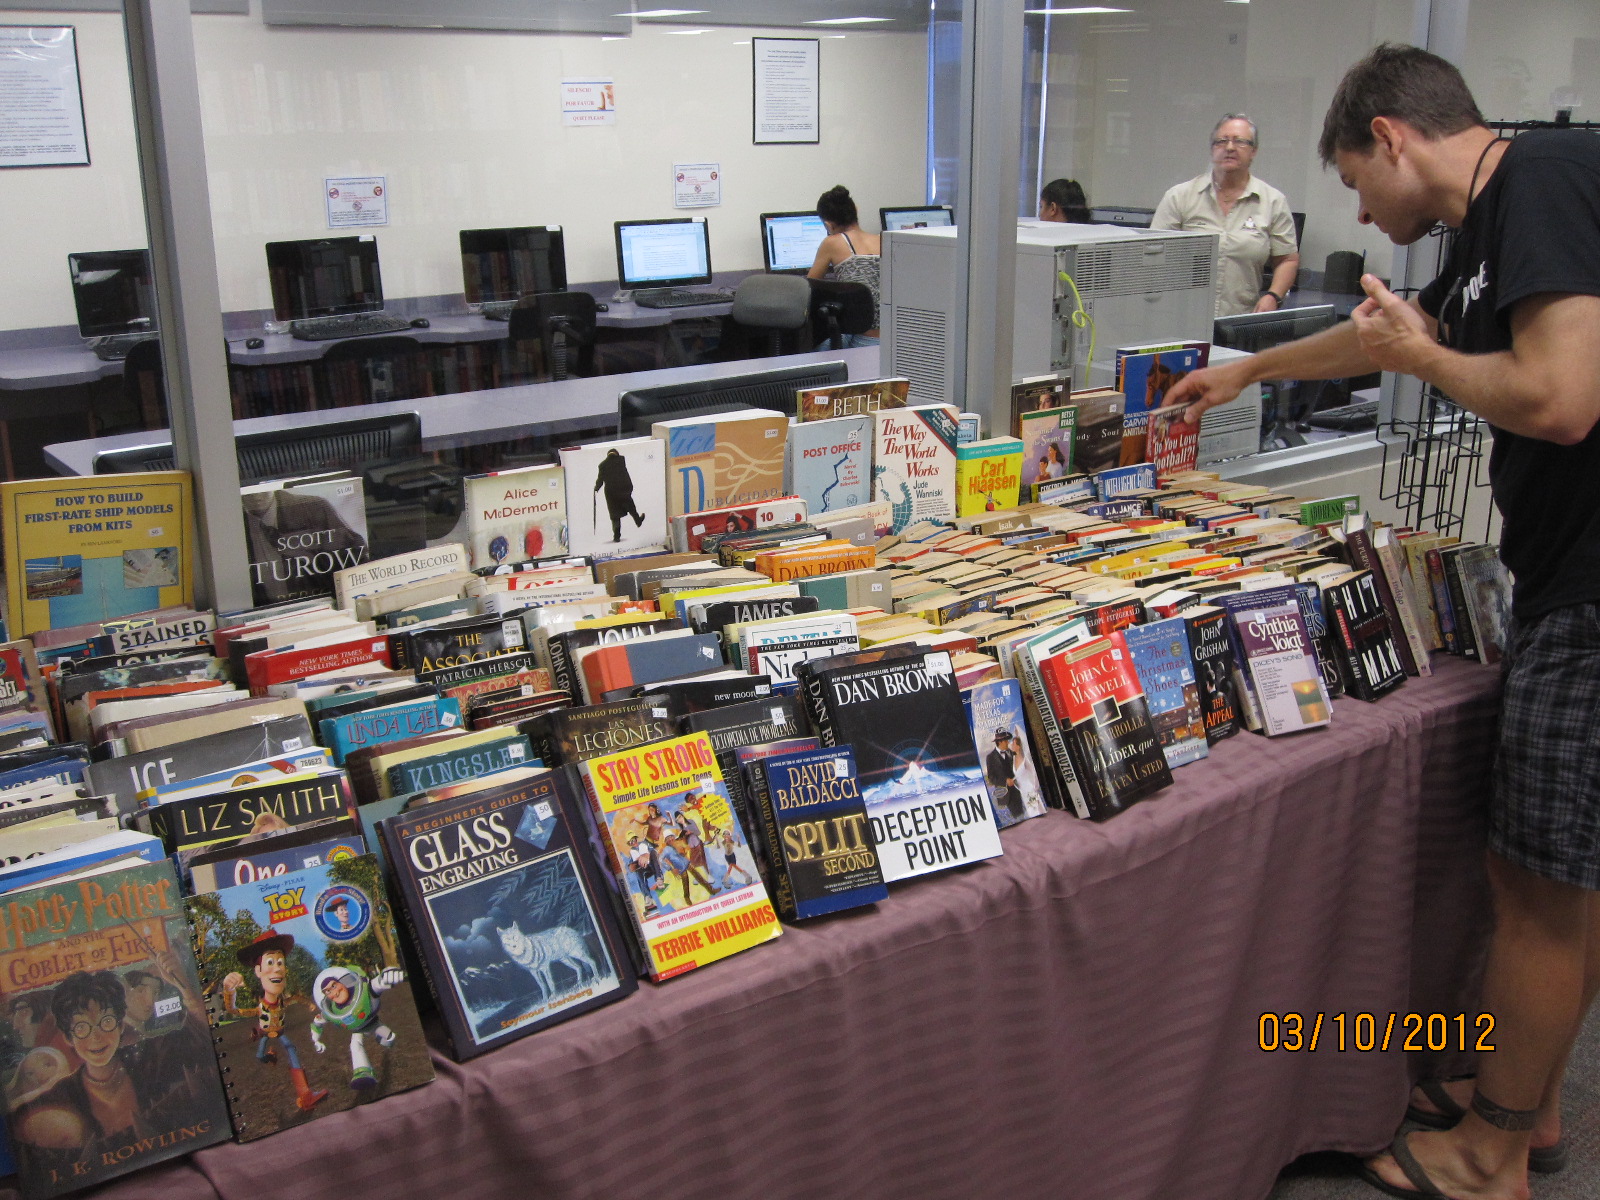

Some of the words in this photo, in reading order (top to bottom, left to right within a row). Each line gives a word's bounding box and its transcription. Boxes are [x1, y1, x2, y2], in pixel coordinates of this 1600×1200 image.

[833, 393, 882, 417] BETH
[1061, 410, 1075, 419] BETSY
[882, 418, 902, 437] The
[902, 424, 927, 442] Way
[1060, 418, 1075, 427] BYARS
[1101, 428, 1120, 439] Soul
[803, 446, 828, 459] POST
[830, 442, 862, 455] OFFICE
[883, 437, 904, 456] The
[904, 442, 938, 460] World
[1164, 437, 1178, 452] You
[1180, 433, 1197, 448] Love
[906, 461, 940, 479] Works
[980, 457, 1007, 478] Carl
[503, 487, 538, 501] Alice
[913, 480, 929, 490] Jude
[915, 489, 943, 499] Wanniski
[968, 474, 1017, 496] Hiaasen
[1104, 475, 1137, 497] INTELLIGENT
[55, 495, 86, 507] HOW
[88, 494, 105, 505] TO
[107, 492, 144, 503] BUILD
[483, 500, 559, 521] McDermott
[1105, 506, 1119, 516] J.A.
[1119, 503, 1142, 514] JANCE
[24, 511, 92, 524] FIRST-RATE
[94, 507, 124, 519] SHIP
[126, 504, 174, 516] MODELS
[760, 512, 773, 522] 10
[998, 520, 1014, 531] Isak
[68, 522, 102, 534] FROM
[105, 520, 133, 531] KITS
[277, 529, 336, 552] SCOTT
[250, 545, 365, 585] TUROW
[347, 573, 368, 587] THE
[367, 564, 407, 581] WORLD
[410, 552, 458, 571] RECORD
[779, 565, 814, 583] DAN
[819, 558, 871, 576] BROWN
[1341, 576, 1380, 621] HIT
[733, 601, 794, 624] JAMES
[1087, 615, 1105, 627] ELOPE
[1106, 606, 1140, 623] FITZGERALD
[119, 619, 207, 649] STAINED
[455, 632, 484, 648] THE
[1200, 626, 1221, 645] JOHN
[1248, 615, 1300, 642] Cynthia
[1146, 645, 1167, 659] The
[1194, 639, 1229, 661] GRISHAM
[1270, 632, 1305, 653] Voigt
[298, 658, 317, 667] NEW
[317, 654, 339, 663] YORK
[340, 649, 364, 658] TIMES
[1137, 658, 1186, 678] Christmas
[1253, 657, 1282, 668] DICEY'S
[1282, 653, 1304, 662] SONG
[1361, 637, 1402, 687] MAN
[435, 663, 485, 684] PATRICIA
[488, 657, 532, 674] HERSCH
[1068, 663, 1101, 688] JOHN
[1100, 655, 1118, 674] C.
[714, 692, 731, 700] new
[733, 689, 756, 699] moon
[832, 677, 880, 707] DAN
[881, 668, 952, 698] BROWN
[1068, 674, 1131, 708] MAXWELL
[1145, 678, 1179, 696] Shoes
[568, 710, 606, 721] SANTIAGO
[608, 702, 659, 715] POSTEGUILLO
[809, 679, 830, 724] DAN
[974, 700, 992, 712] MADE
[992, 696, 1005, 707] FOR
[1212, 697, 1225, 708] THE
[608, 719, 625, 730] LAS
[982, 708, 1001, 719] TEXAS
[1205, 706, 1235, 729] APPEAL
[347, 716, 400, 744] LINDA
[406, 708, 443, 734] LAEL
[573, 721, 664, 753] LEGIONES
[710, 730, 749, 751] CICLOPEDIA
[750, 728, 758, 741] DE
[758, 719, 798, 742] PROBLEMAS
[1033, 688, 1056, 733] MINIATURE
[1049, 732, 1077, 784] SCHNAUZERS
[1083, 715, 1147, 752] DESARROLLE
[597, 757, 641, 793] STAY
[649, 738, 713, 781] STRONG
[1093, 758, 1101, 774] el
[1098, 744, 1137, 770] LÍDER
[1138, 737, 1154, 754] que
[786, 760, 837, 788] DAVID
[1131, 758, 1164, 780] USTED
[582, 773, 600, 814] WILLIAMS
[612, 790, 637, 805] Simple
[637, 785, 651, 798] Life
[650, 780, 680, 795] Lessons
[680, 777, 690, 788] for
[691, 769, 713, 784] Teens
[776, 776, 860, 812] BALDACCI
[180, 802, 232, 836] LIZ
[238, 783, 342, 826] SMITH
[401, 827, 410, 838] A
[414, 804, 485, 834] BEGINNER'S
[490, 791, 527, 811] GUIDE
[533, 785, 549, 796] TO
[869, 794, 987, 846] DECEPTION
[409, 811, 512, 874] GLASS
[782, 812, 868, 863] SPLIT
[903, 830, 968, 871] POINT
[234, 858, 288, 886] One
[417, 847, 520, 895] ENGRAVING
[823, 852, 875, 877] SECOND
[284, 876, 305, 886] PIXAR
[262, 885, 306, 914] TOY
[656, 919, 671, 930] WITH
[671, 917, 678, 925] AN
[678, 907, 713, 923] INTRODUCTION
[713, 903, 720, 911] BY
[720, 897, 736, 909] QUEEN
[736, 891, 754, 904] LATIFAH
[0, 892, 78, 950] Harry
[78, 878, 174, 931] Potter
[272, 906, 305, 921] STORY
[58, 937, 81, 949] AND
[83, 930, 104, 942] THE
[651, 930, 704, 964] TERRIE
[703, 904, 776, 944] WILLIAMS
[8, 951, 86, 987] GOBLET
[91, 947, 106, 963] OF
[106, 933, 156, 965] FIRE
[499, 1006, 546, 1030] Seymour
[547, 986, 593, 1010] Isenberg
[50, 1168, 62, 1184] J.
[72, 1161, 92, 1178] K.
[101, 1119, 211, 1167] ROWLING
